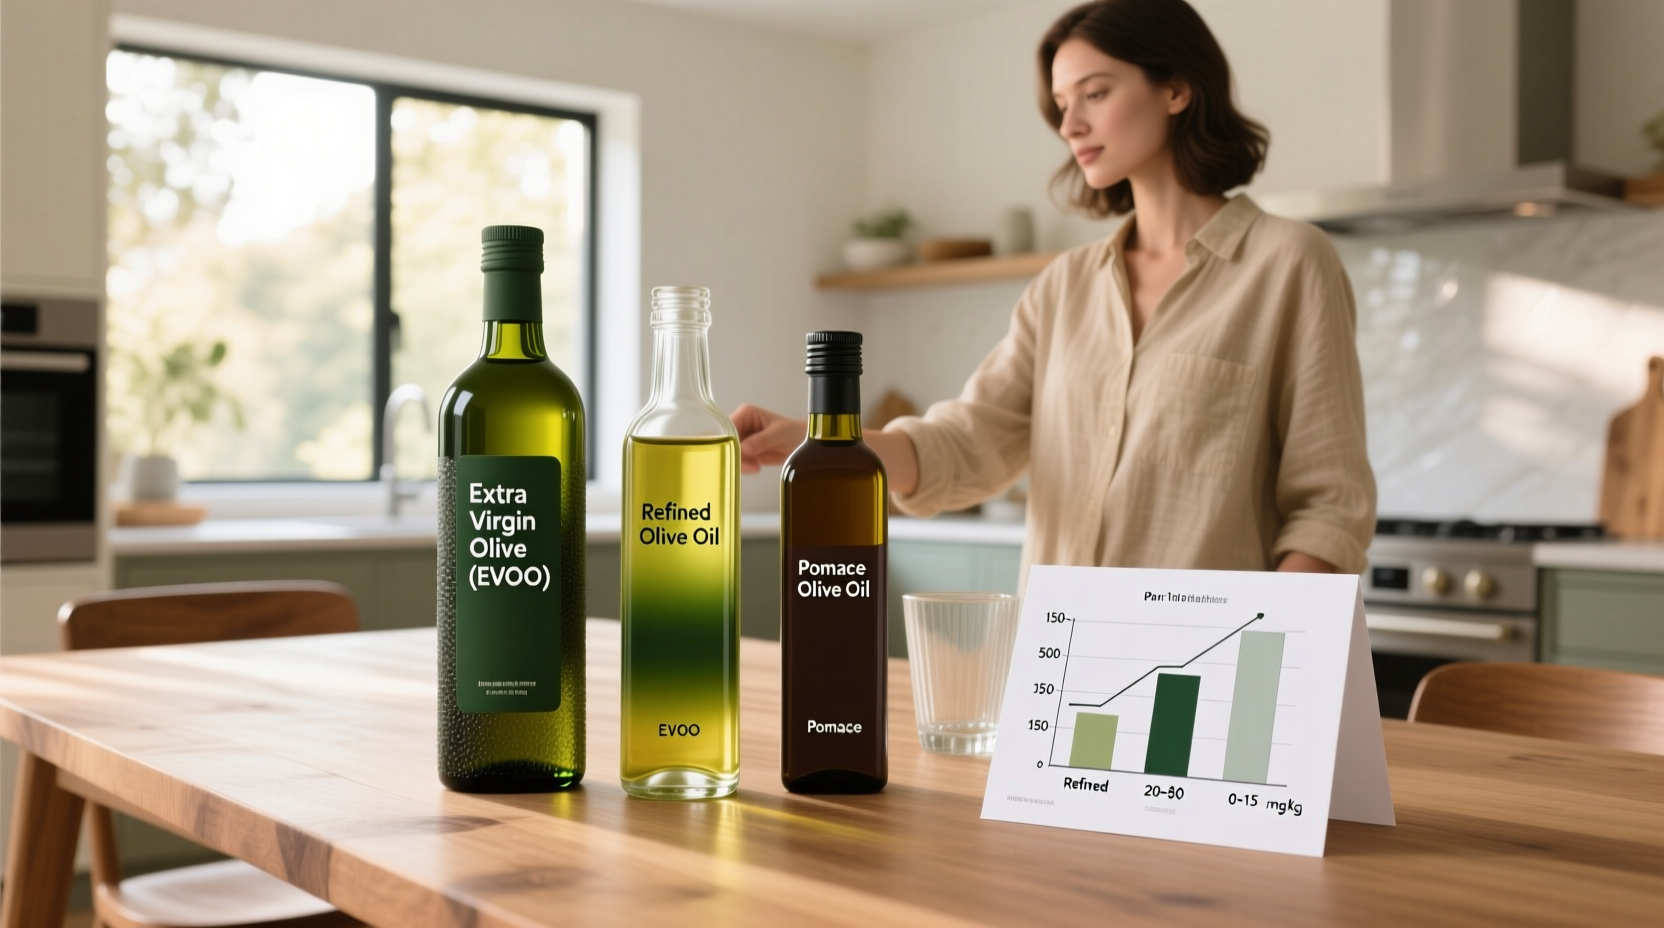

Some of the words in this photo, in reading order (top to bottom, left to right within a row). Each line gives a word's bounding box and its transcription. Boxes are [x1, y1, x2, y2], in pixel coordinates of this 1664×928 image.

[469, 482, 527, 504] Extra
[642, 502, 711, 521] Refined
[469, 510, 536, 537] Virgin
[639, 527, 688, 545] Olive
[693, 527, 720, 545] Oil
[469, 537, 527, 558] Olive
[798, 559, 867, 576] Pomace
[468, 564, 551, 592] (EVOO)
[797, 580, 842, 598] Olive
[845, 580, 871, 598] Oil
[1038, 646, 1061, 659] 500
[658, 723, 701, 737] EVOO
[807, 719, 863, 734] Pomace
[1027, 719, 1049, 732] 150
[1228, 792, 1259, 807] 0-15
